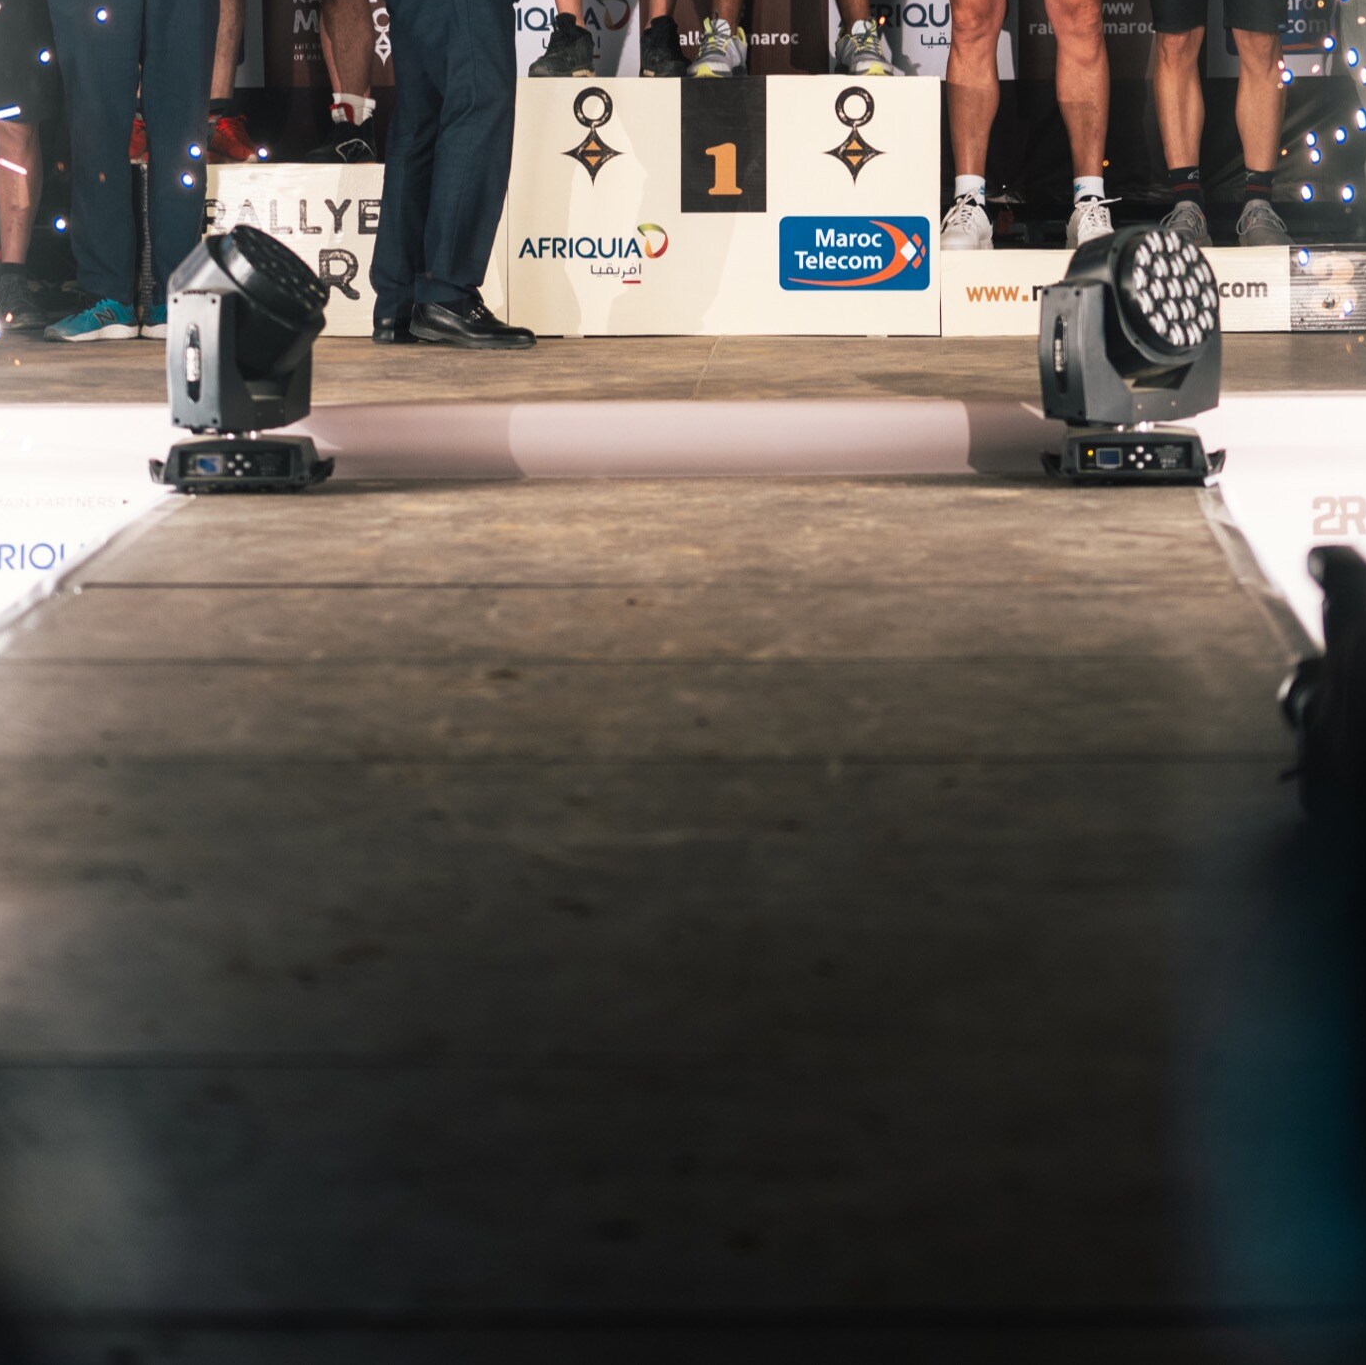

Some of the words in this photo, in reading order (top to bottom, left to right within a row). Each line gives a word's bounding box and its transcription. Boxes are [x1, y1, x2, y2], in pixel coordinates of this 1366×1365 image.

[704, 141, 743, 196] 1
[518, 236, 643, 259] AFRIQUIA
[815, 228, 882, 248] Maroc
[794, 250, 883, 271] Telecom
